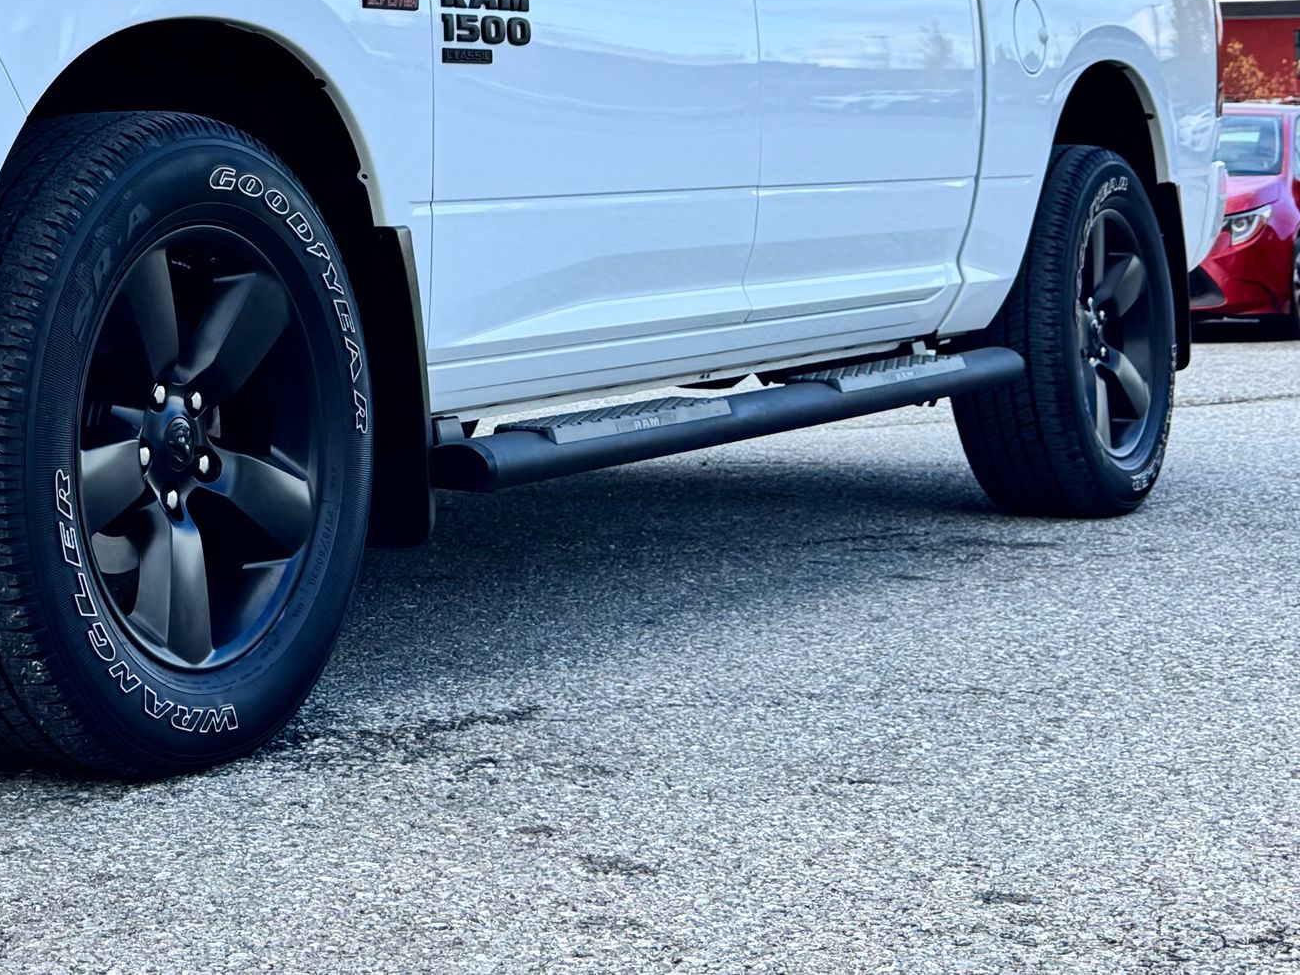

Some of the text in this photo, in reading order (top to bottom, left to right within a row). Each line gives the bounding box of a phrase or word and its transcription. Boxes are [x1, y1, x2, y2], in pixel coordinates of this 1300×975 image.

[440, 13, 532, 46] 1500
[444, 48, 492, 62] CLASSIC
[209, 164, 372, 436] GOODYEAR
[634, 416, 661, 431] RAM
[54, 468, 239, 734] WRANGLER
